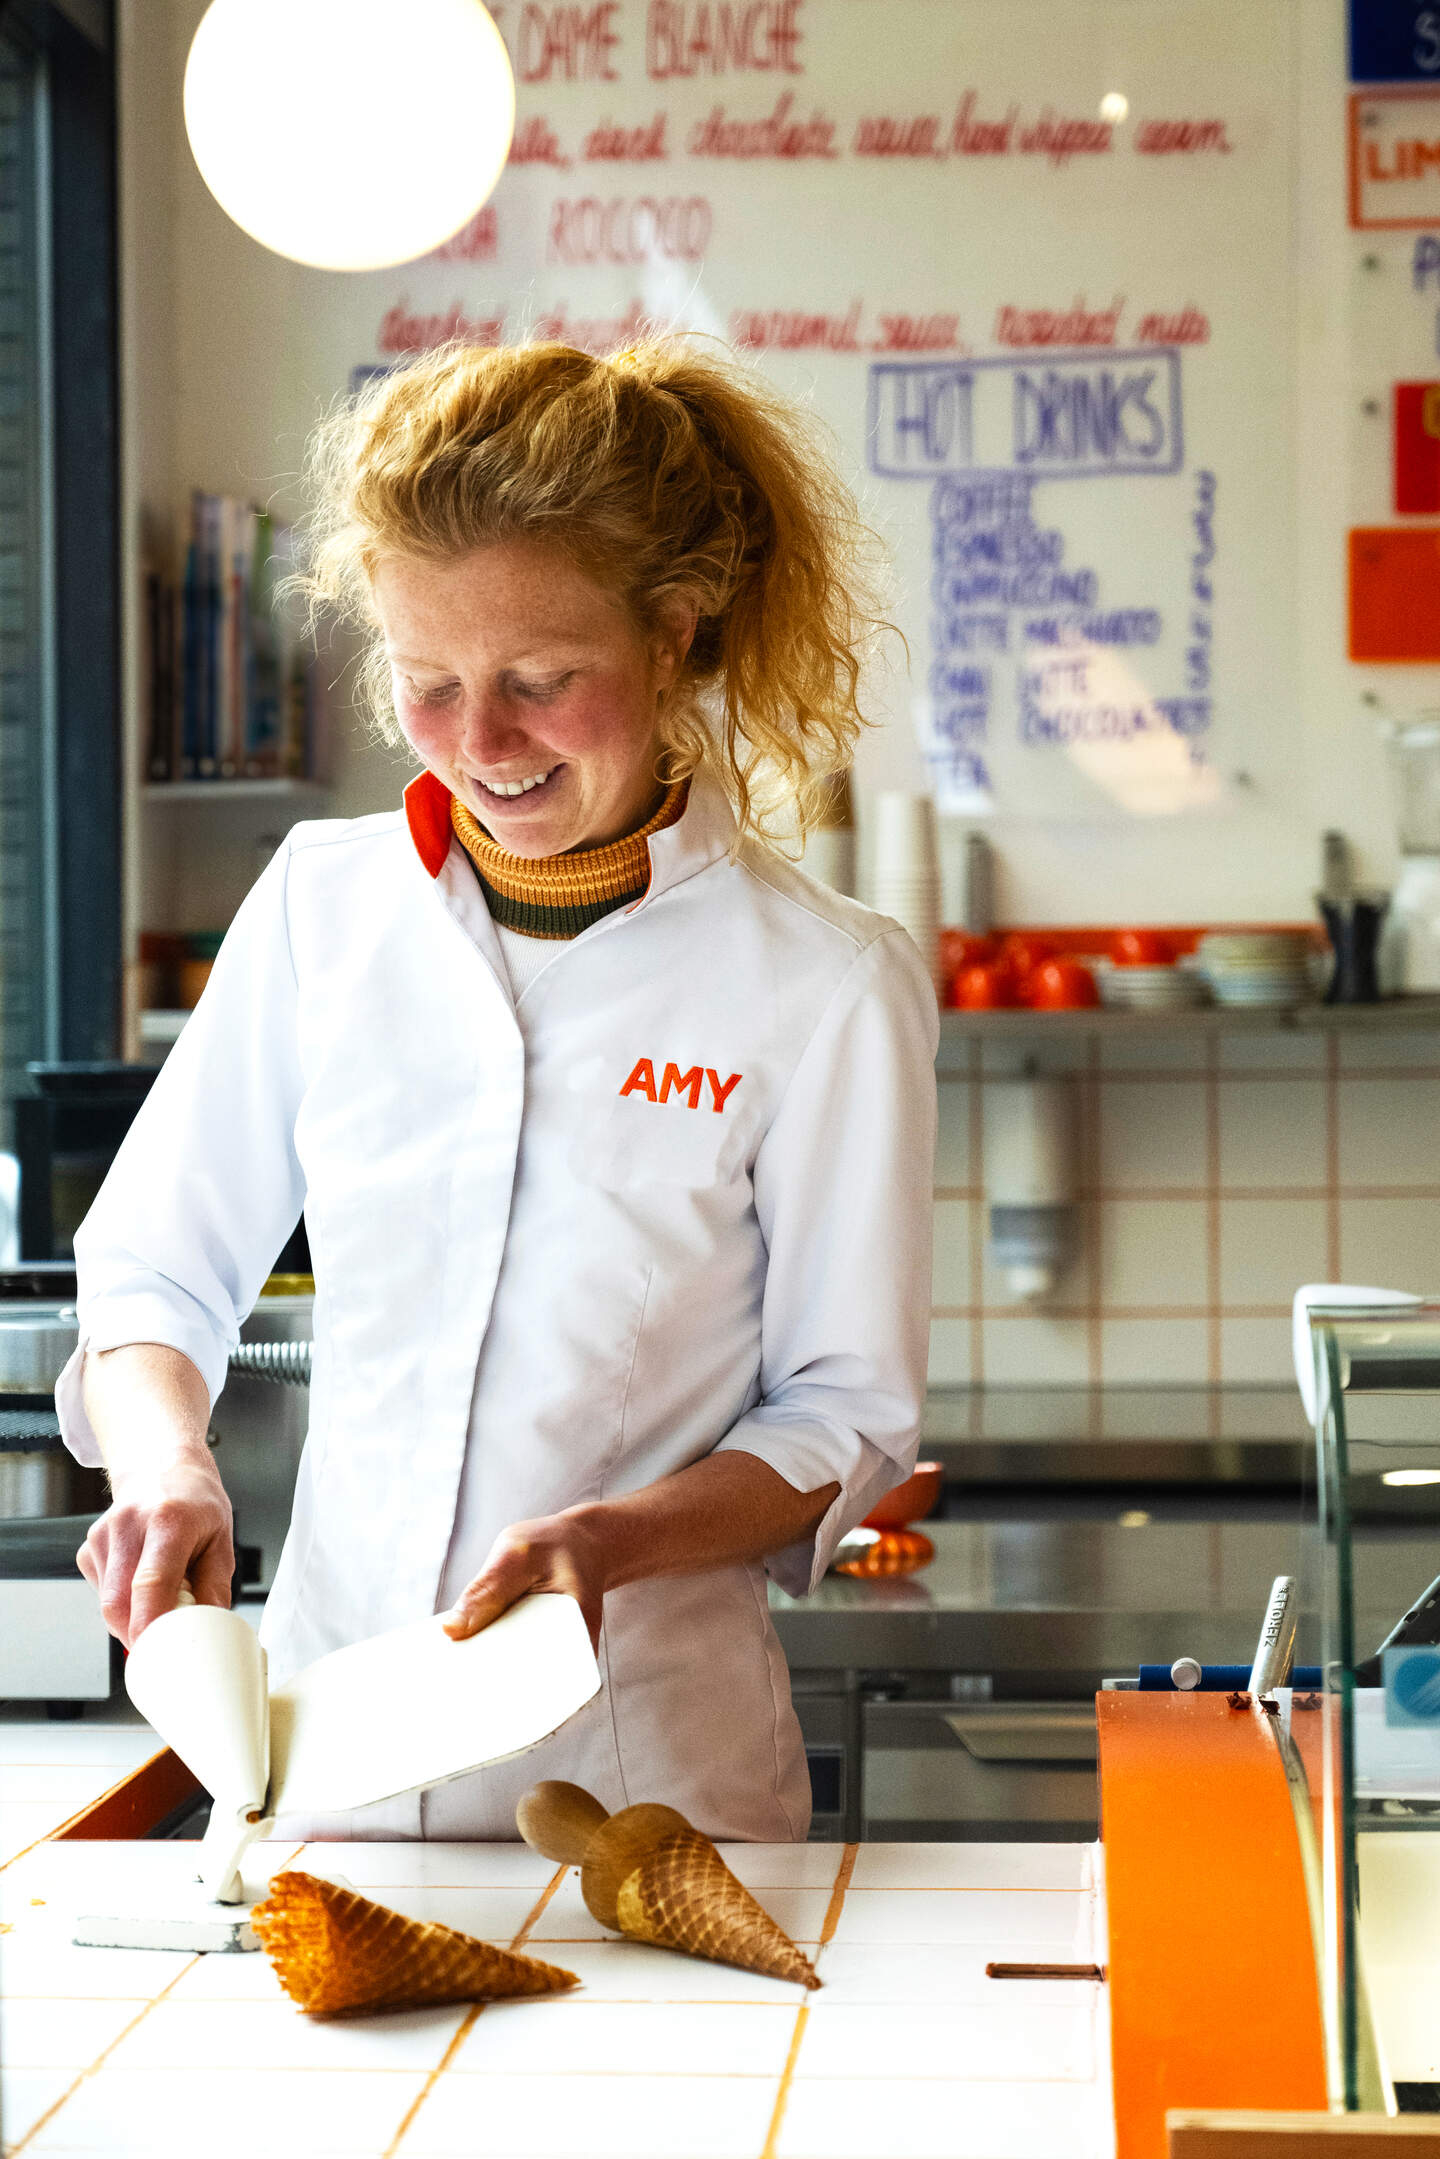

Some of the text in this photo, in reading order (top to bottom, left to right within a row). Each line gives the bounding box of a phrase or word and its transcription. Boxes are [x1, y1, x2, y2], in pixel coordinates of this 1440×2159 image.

[518, 0, 806, 83] DAME BLANCHE
[896, 369, 1166, 464] HOT DRINKS
[929, 473, 1038, 528] COFFEE
[618, 1057, 743, 1113] AMY
